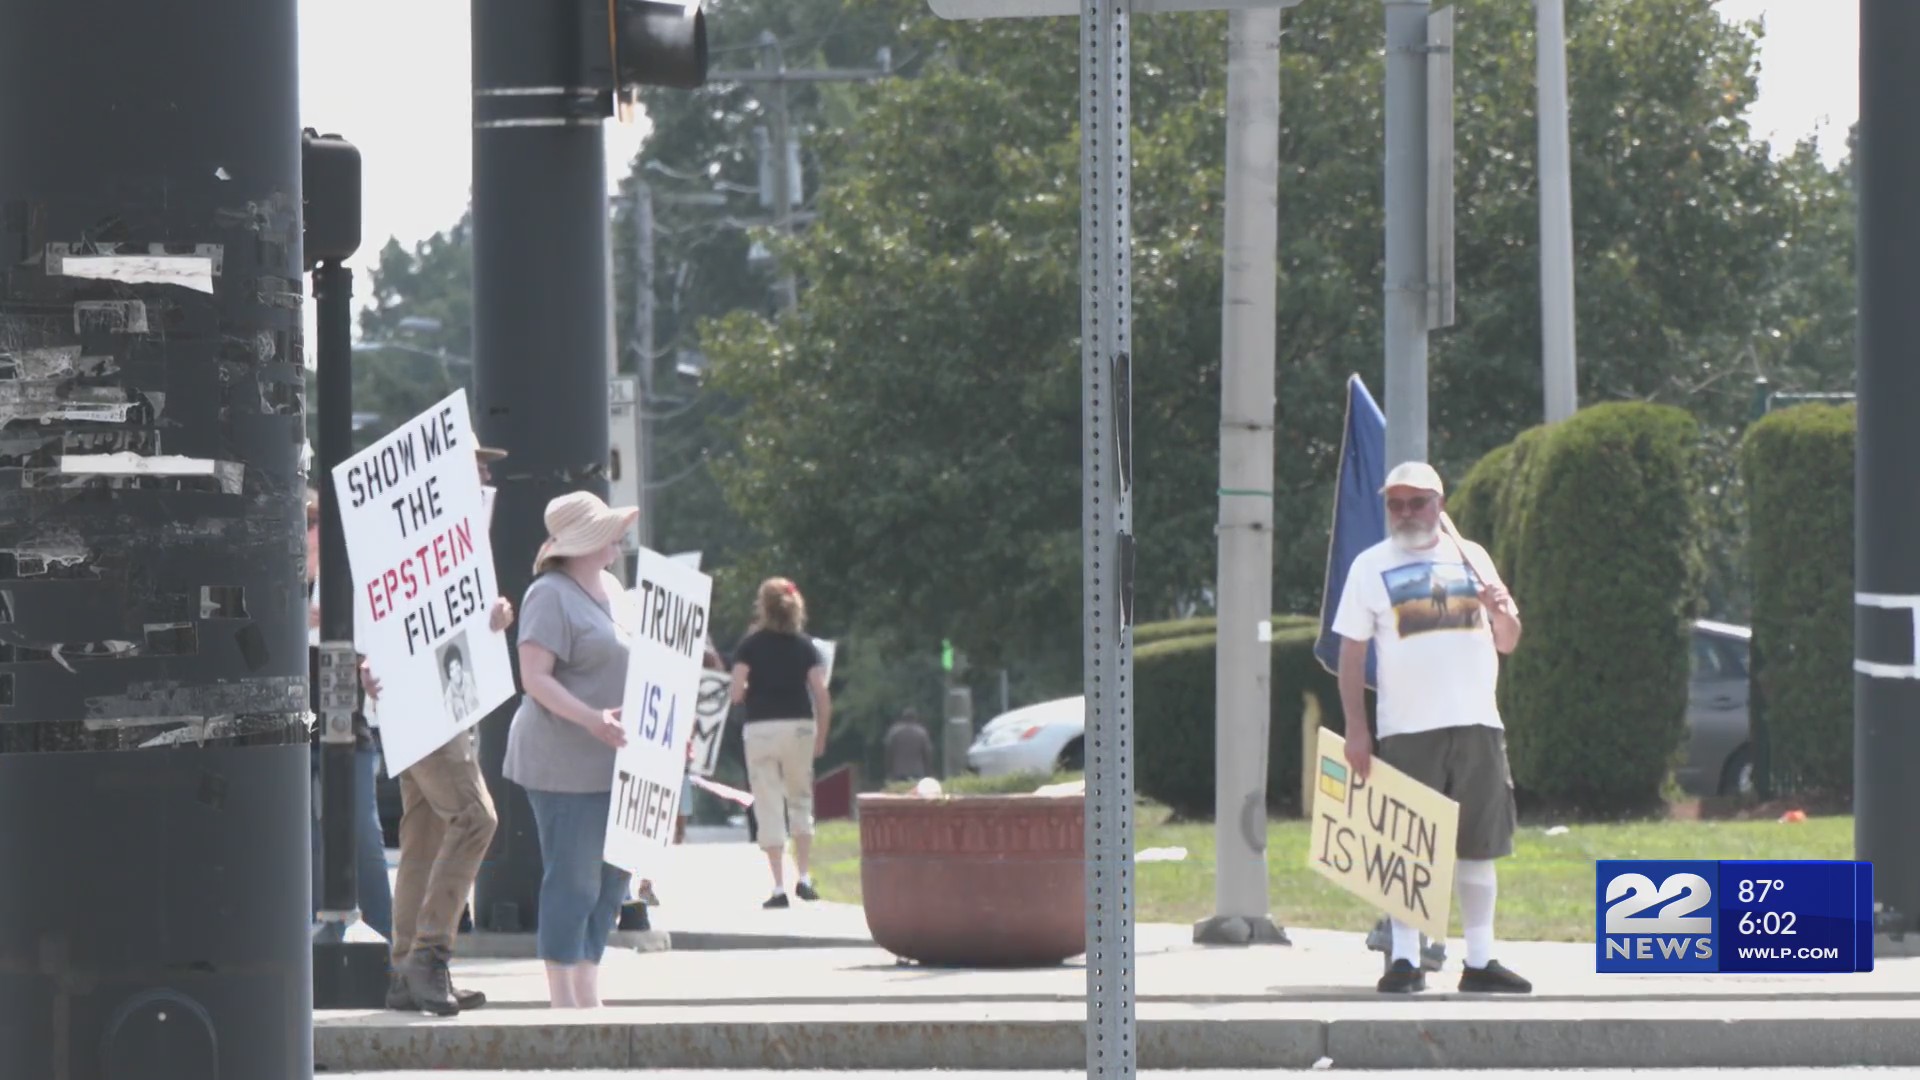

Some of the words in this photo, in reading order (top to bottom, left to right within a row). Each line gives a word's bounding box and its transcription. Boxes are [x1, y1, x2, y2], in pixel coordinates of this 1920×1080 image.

[348, 432, 416, 507] SHOW
[420, 407, 456, 463] ME
[392, 476, 442, 538] THE
[367, 517, 474, 622] EPSTEIN
[404, 567, 485, 656] FILES!
[641, 579, 704, 658] TRUMP
[638, 681, 662, 742] IS
[662, 694, 676, 750] A
[616, 770, 676, 847] THIEF!
[1348, 770, 1436, 865] PUTIN
[1319, 813, 1356, 873] IS
[1361, 834, 1431, 920] WAR
